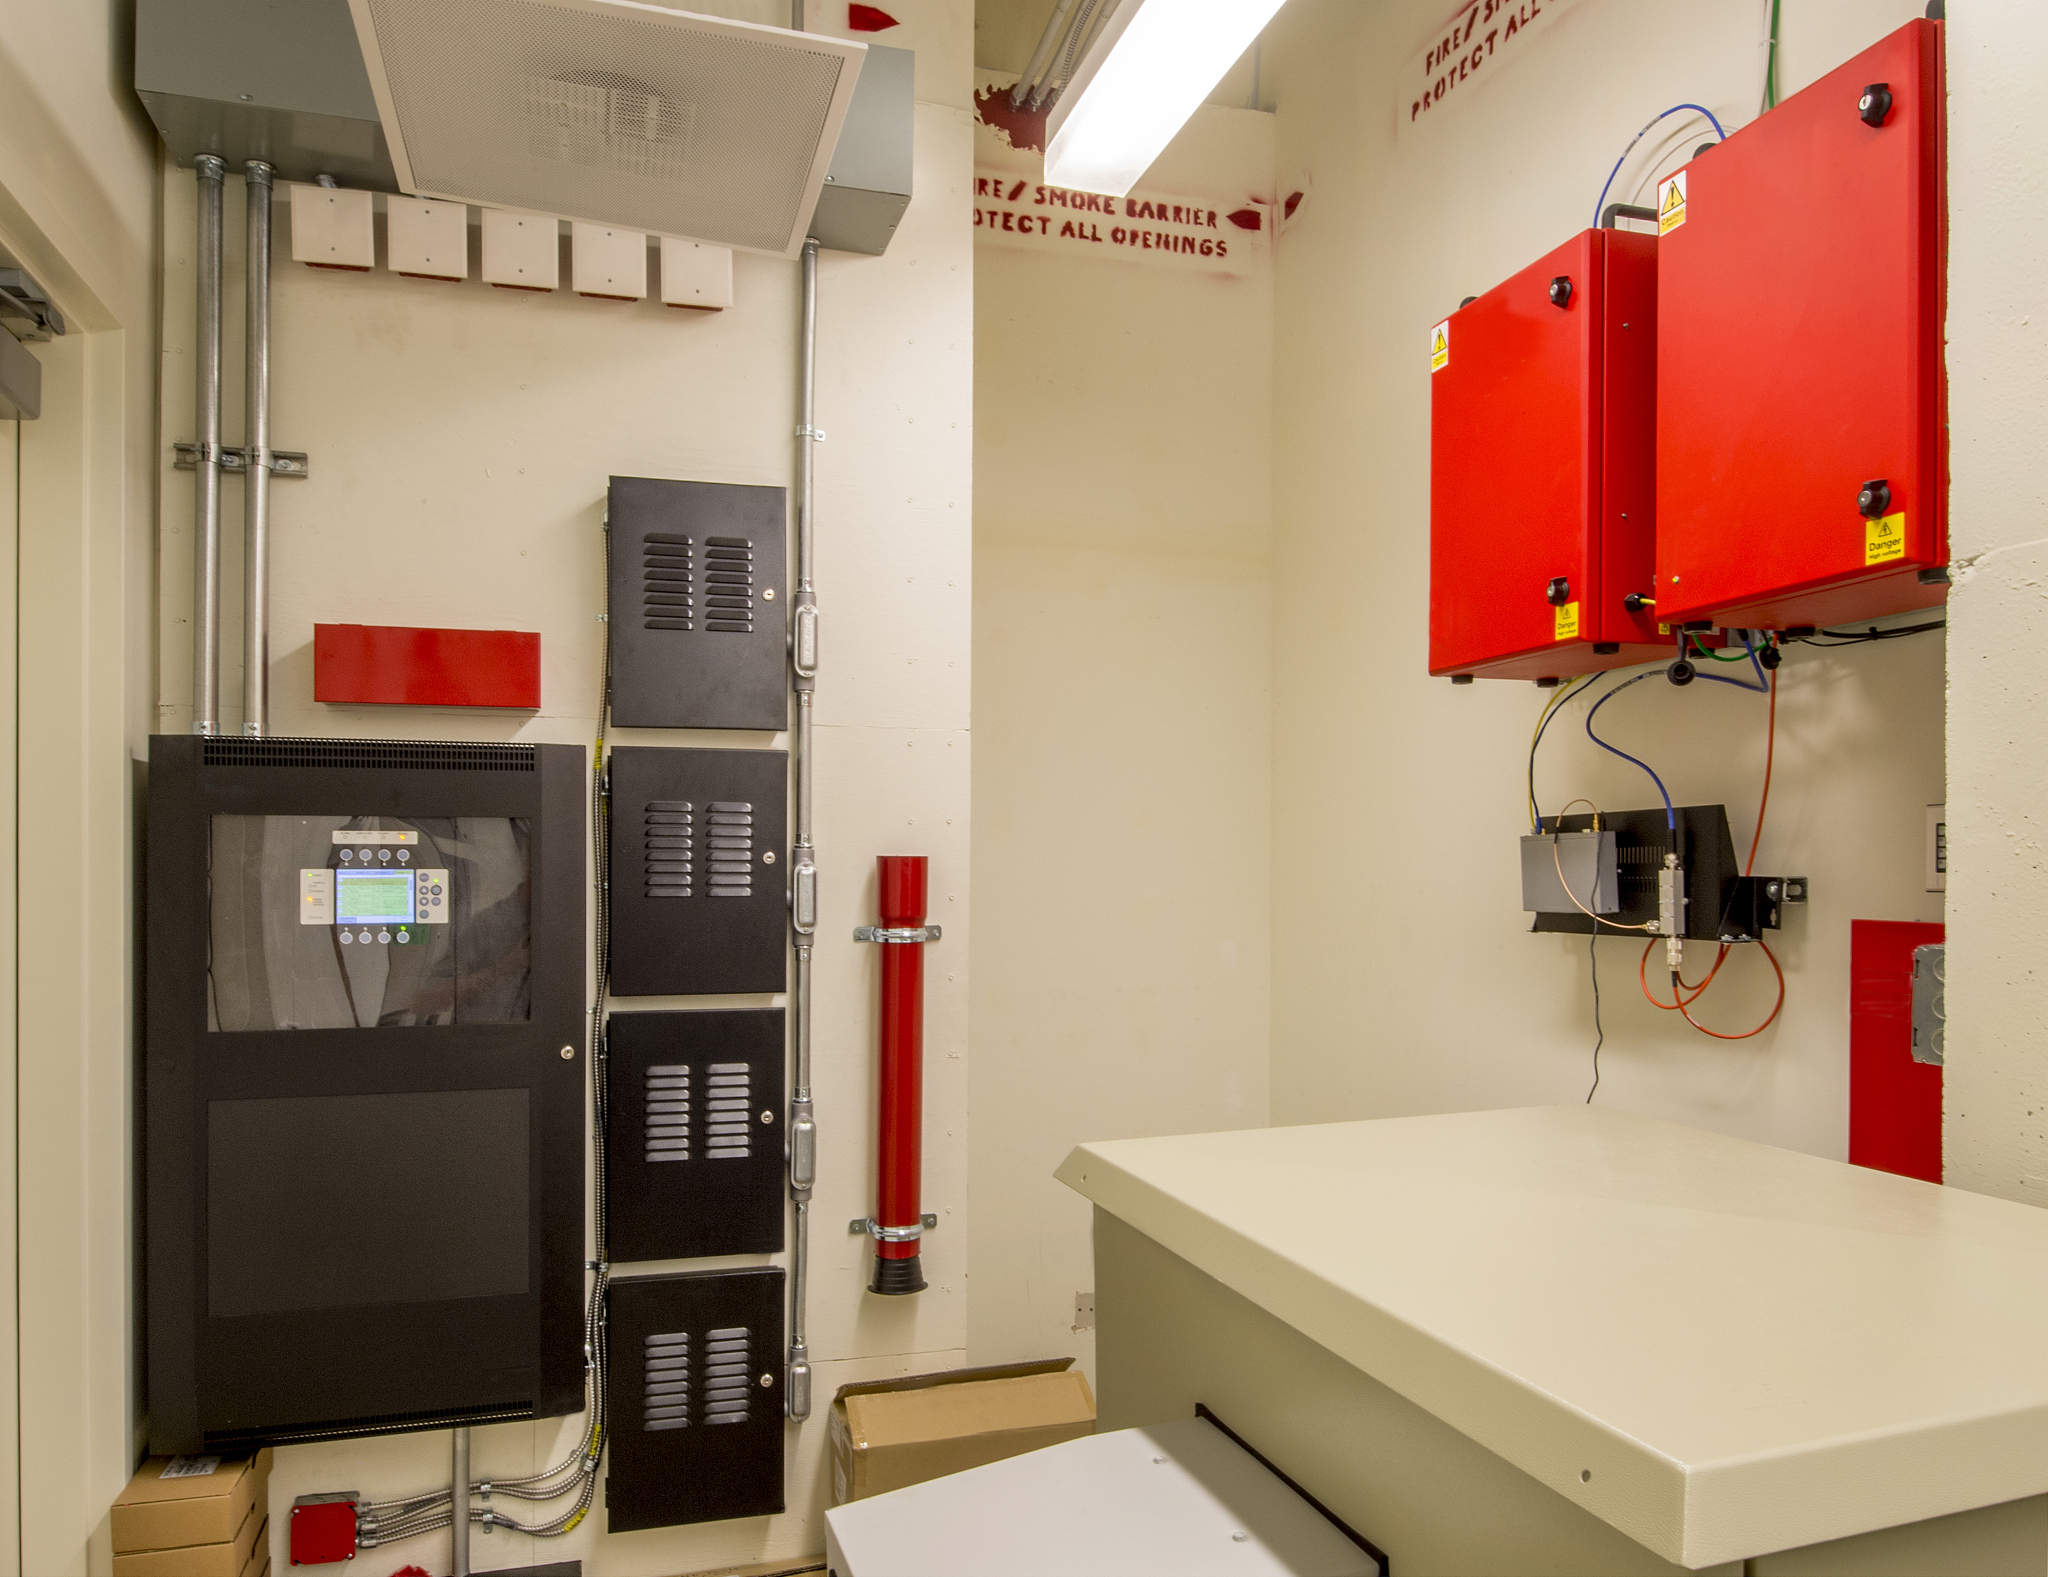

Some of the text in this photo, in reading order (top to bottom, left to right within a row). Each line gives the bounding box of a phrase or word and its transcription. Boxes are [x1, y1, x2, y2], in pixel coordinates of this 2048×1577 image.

[1412, 0, 1541, 122] PROTECT ALL
[1033, 186, 1116, 215] SMOKE
[1126, 198, 1217, 229] BARRIER
[1060, 220, 1103, 242] ALL
[1111, 226, 1228, 257] OPENINGS
[1869, 538, 1901, 551] Danger
